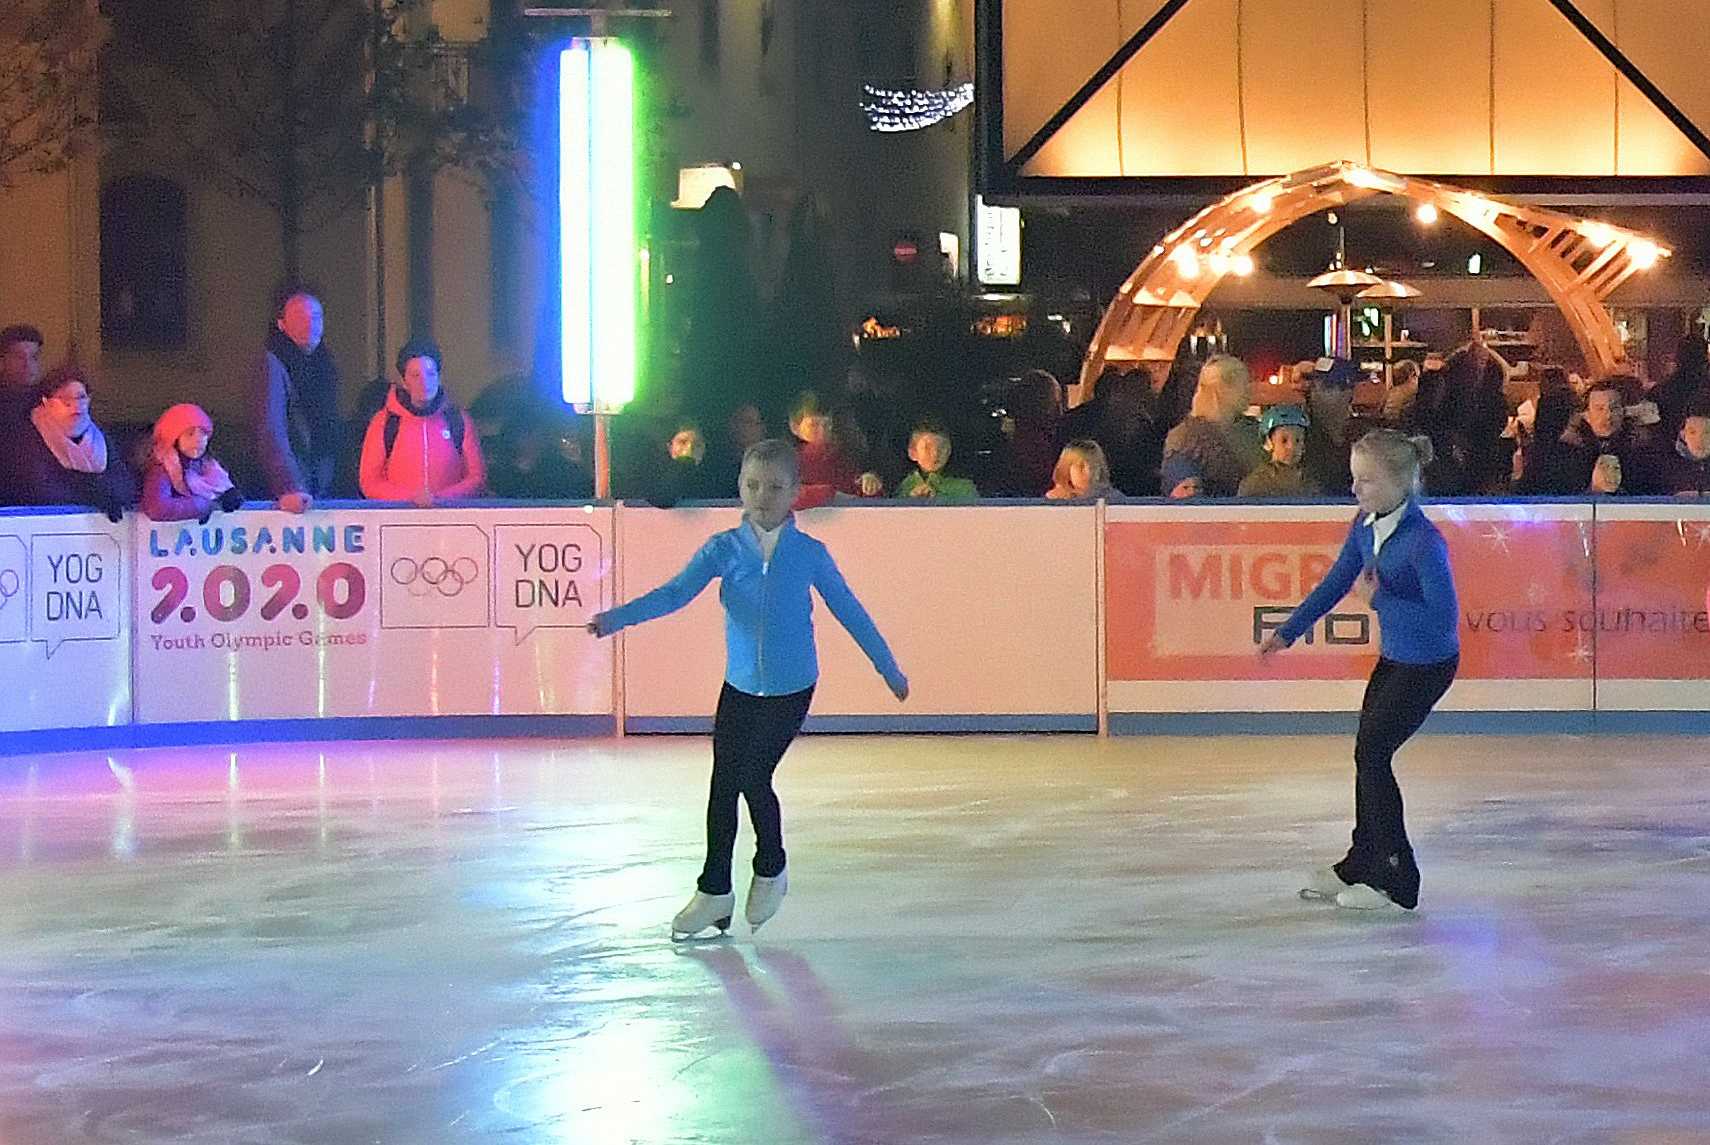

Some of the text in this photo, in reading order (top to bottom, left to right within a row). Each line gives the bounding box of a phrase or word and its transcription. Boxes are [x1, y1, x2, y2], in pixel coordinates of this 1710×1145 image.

[150, 525, 365, 557] LAUSANNE
[47, 553, 103, 584] YOG
[514, 543, 582, 572] YOG
[1168, 551, 1336, 600] MIGR
[46, 590, 103, 621] DNA
[515, 579, 582, 608] DNA
[1467, 610, 1547, 633] vous
[151, 630, 367, 652] Youth Olympic Games
